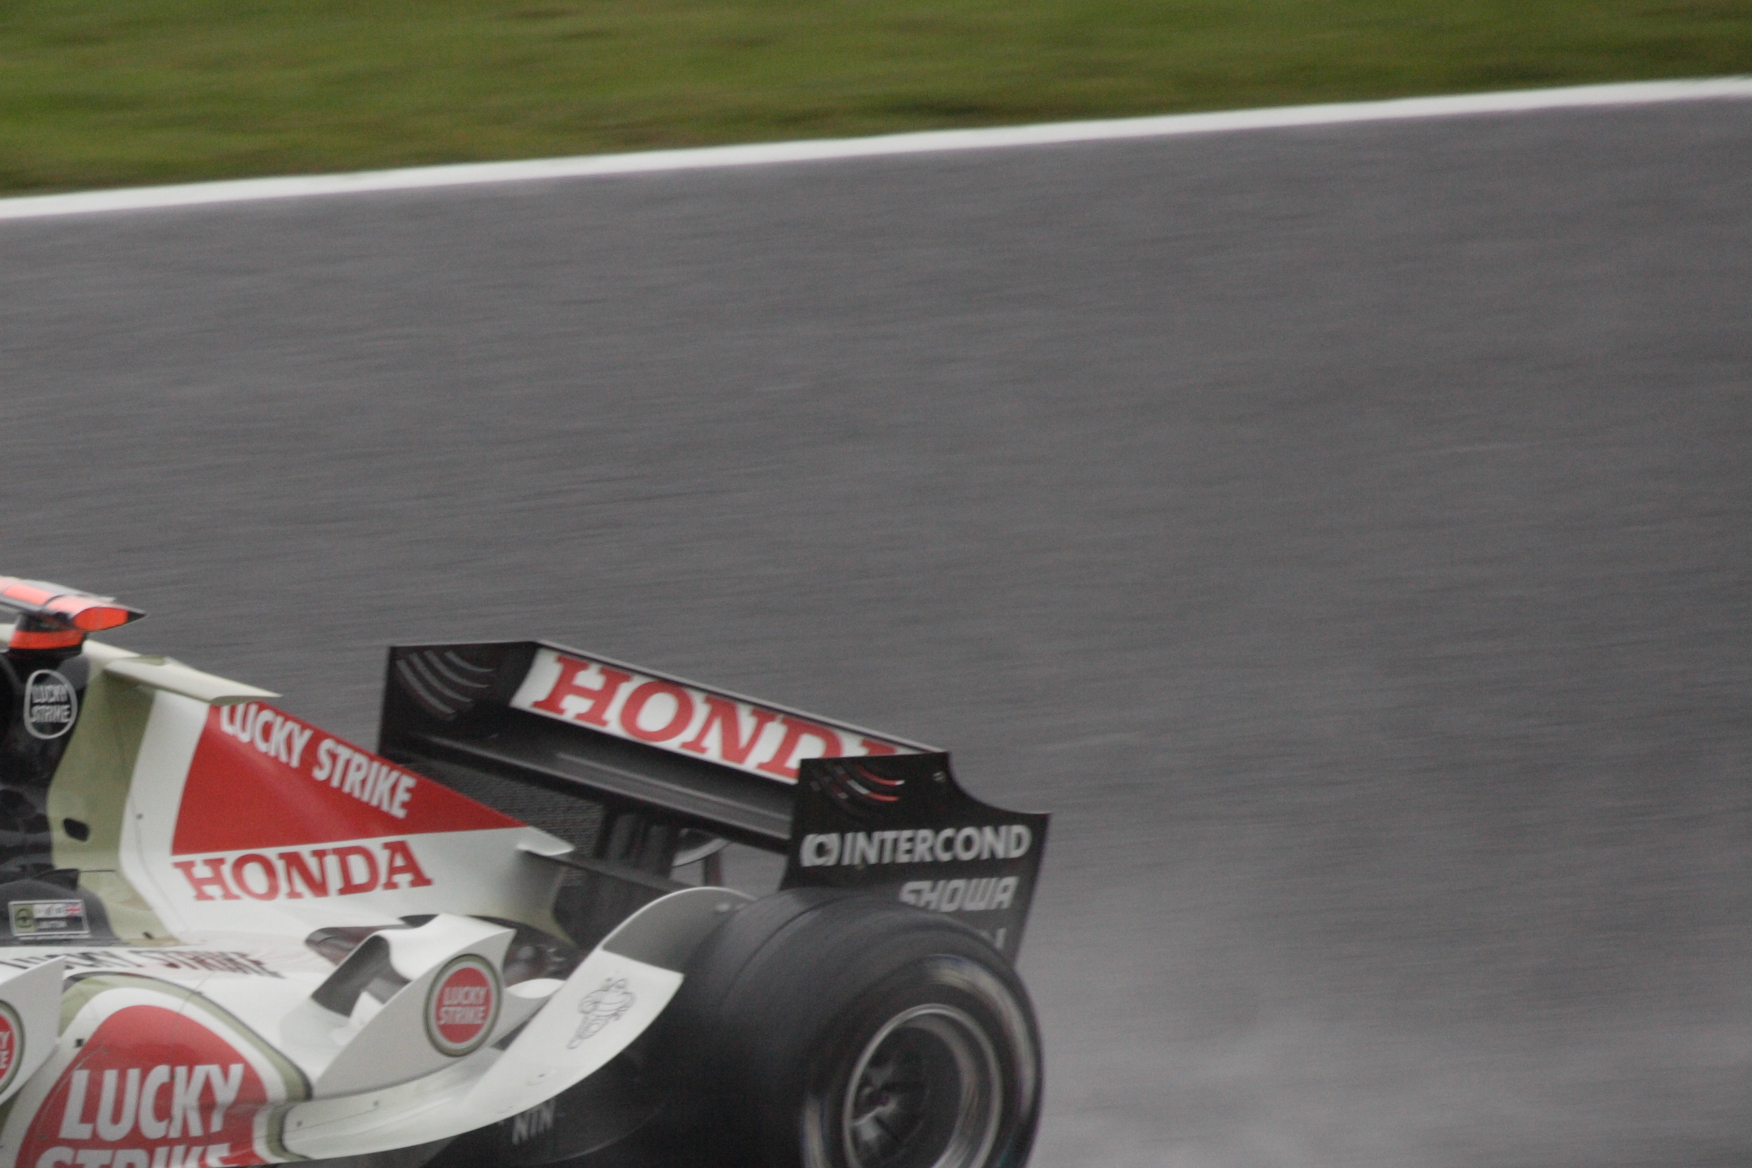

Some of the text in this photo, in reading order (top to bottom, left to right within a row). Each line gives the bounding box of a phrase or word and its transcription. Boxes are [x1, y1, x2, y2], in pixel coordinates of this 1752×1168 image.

[532, 654, 896, 782] HOND
[219, 702, 417, 820] LUCKY STRIKE
[172, 840, 434, 901] HONDA
[840, 824, 1033, 867] INTERCOND
[899, 875, 1020, 912] SHOWA
[438, 1005, 487, 1025] STRIKE
[443, 986, 488, 1005] LUCKY
[58, 1062, 245, 1142] LUCKY
